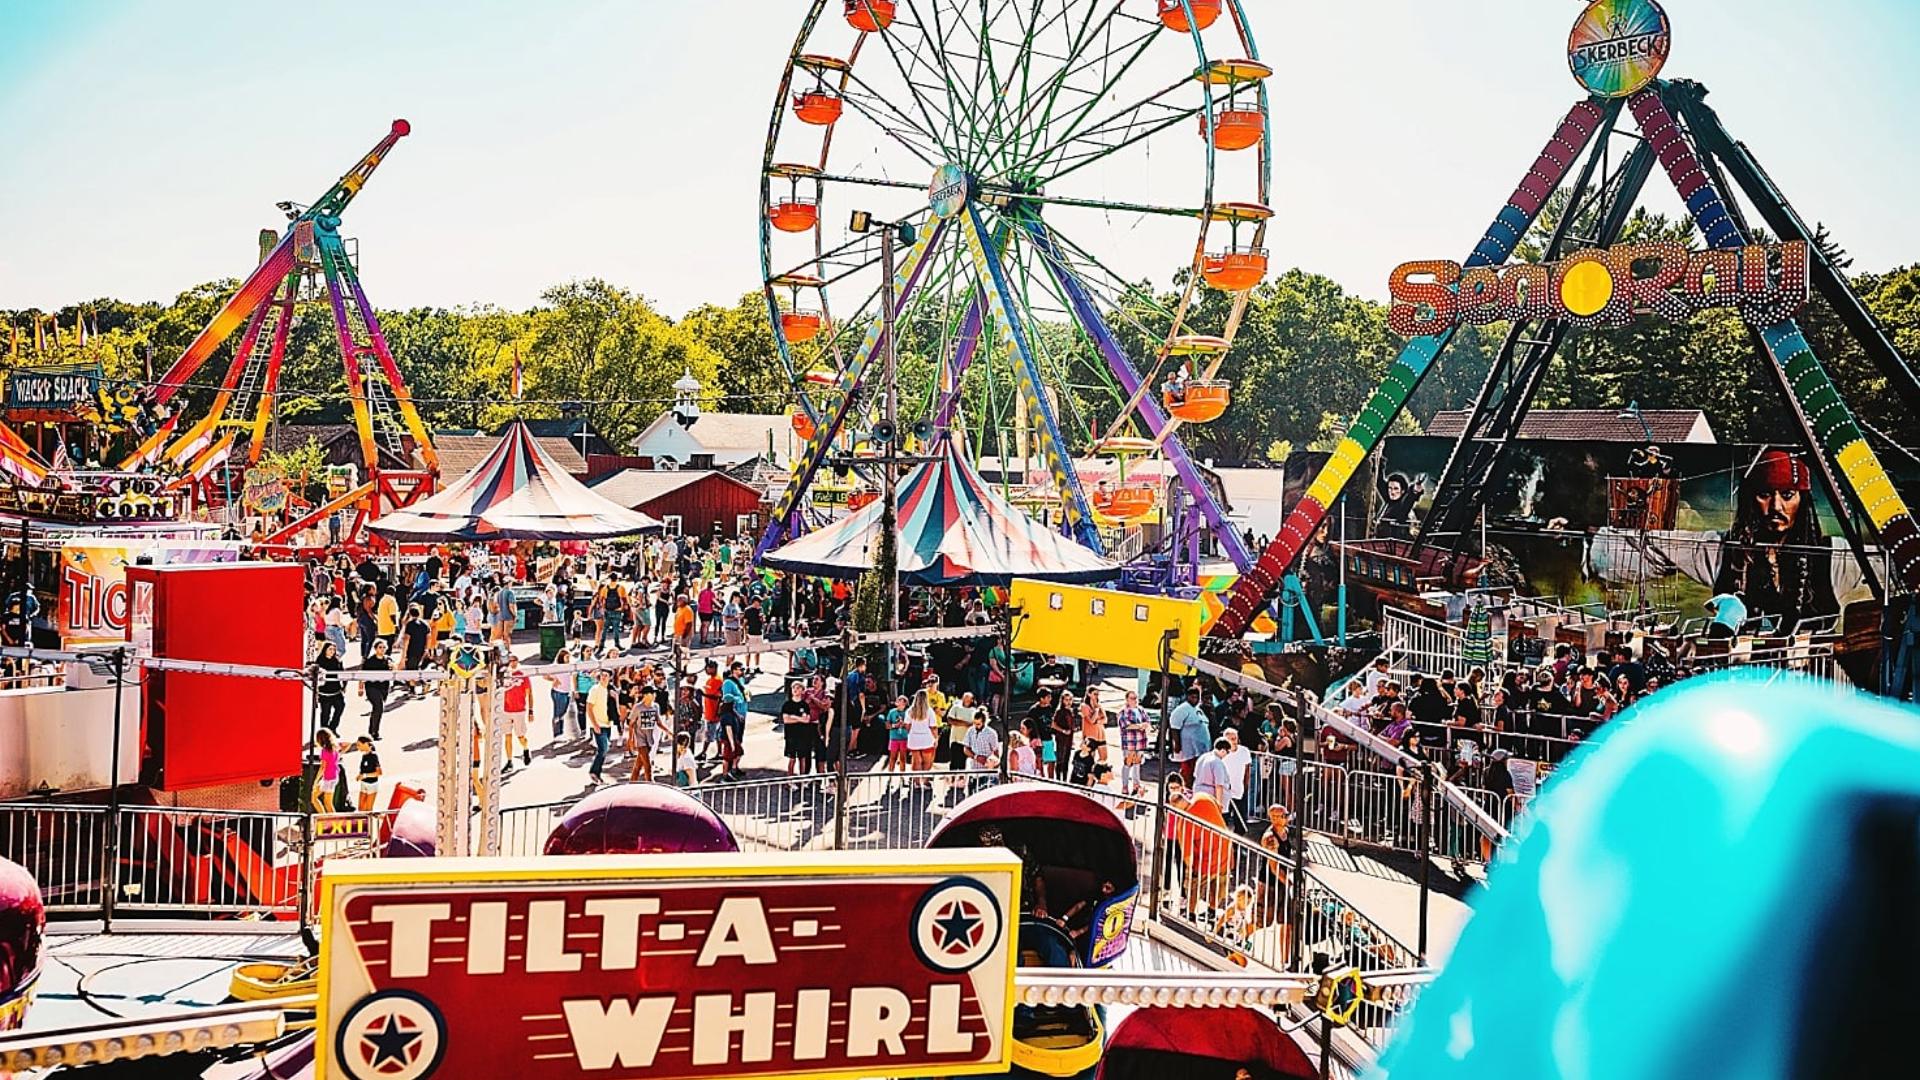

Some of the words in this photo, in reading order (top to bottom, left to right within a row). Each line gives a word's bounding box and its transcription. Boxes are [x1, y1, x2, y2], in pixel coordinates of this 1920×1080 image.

[1574, 34, 1662, 69] SKERBECK
[16, 377, 52, 402] WACKY
[118, 478, 155, 497] POP
[98, 501, 168, 518] CORN
[317, 819, 366, 836] EXIT
[562, 984, 974, 1070] WHIRL
